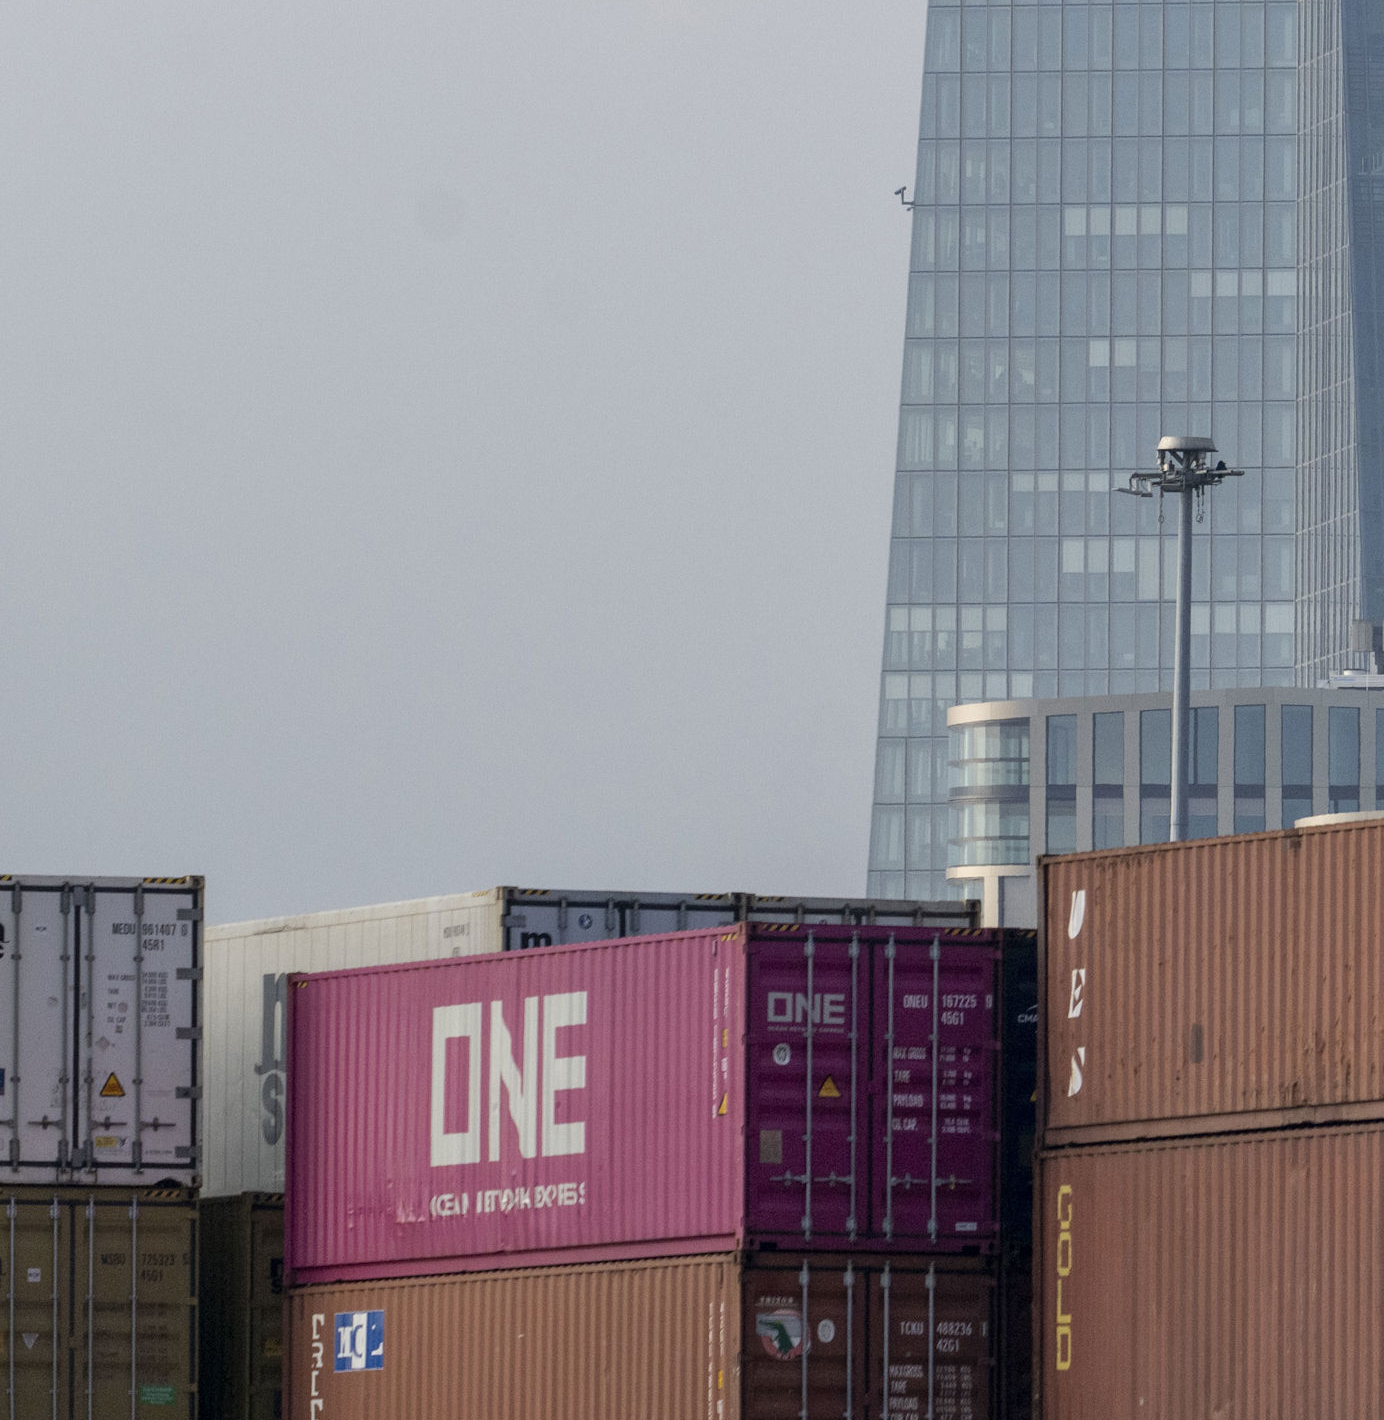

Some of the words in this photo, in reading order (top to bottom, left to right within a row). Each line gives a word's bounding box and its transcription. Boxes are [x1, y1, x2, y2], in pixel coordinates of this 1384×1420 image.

[112, 923, 136, 935] MEDU
[767, 992, 845, 1024] ONE
[903, 994, 928, 1009] ONEU
[941, 994, 977, 1009] 167225
[940, 1011, 965, 1026] 45G1
[430, 990, 587, 1168] ONE
[899, 1321, 924, 1336] TCKU
[935, 1321, 973, 1337] 488236
[935, 1337, 960, 1353] 42G1
